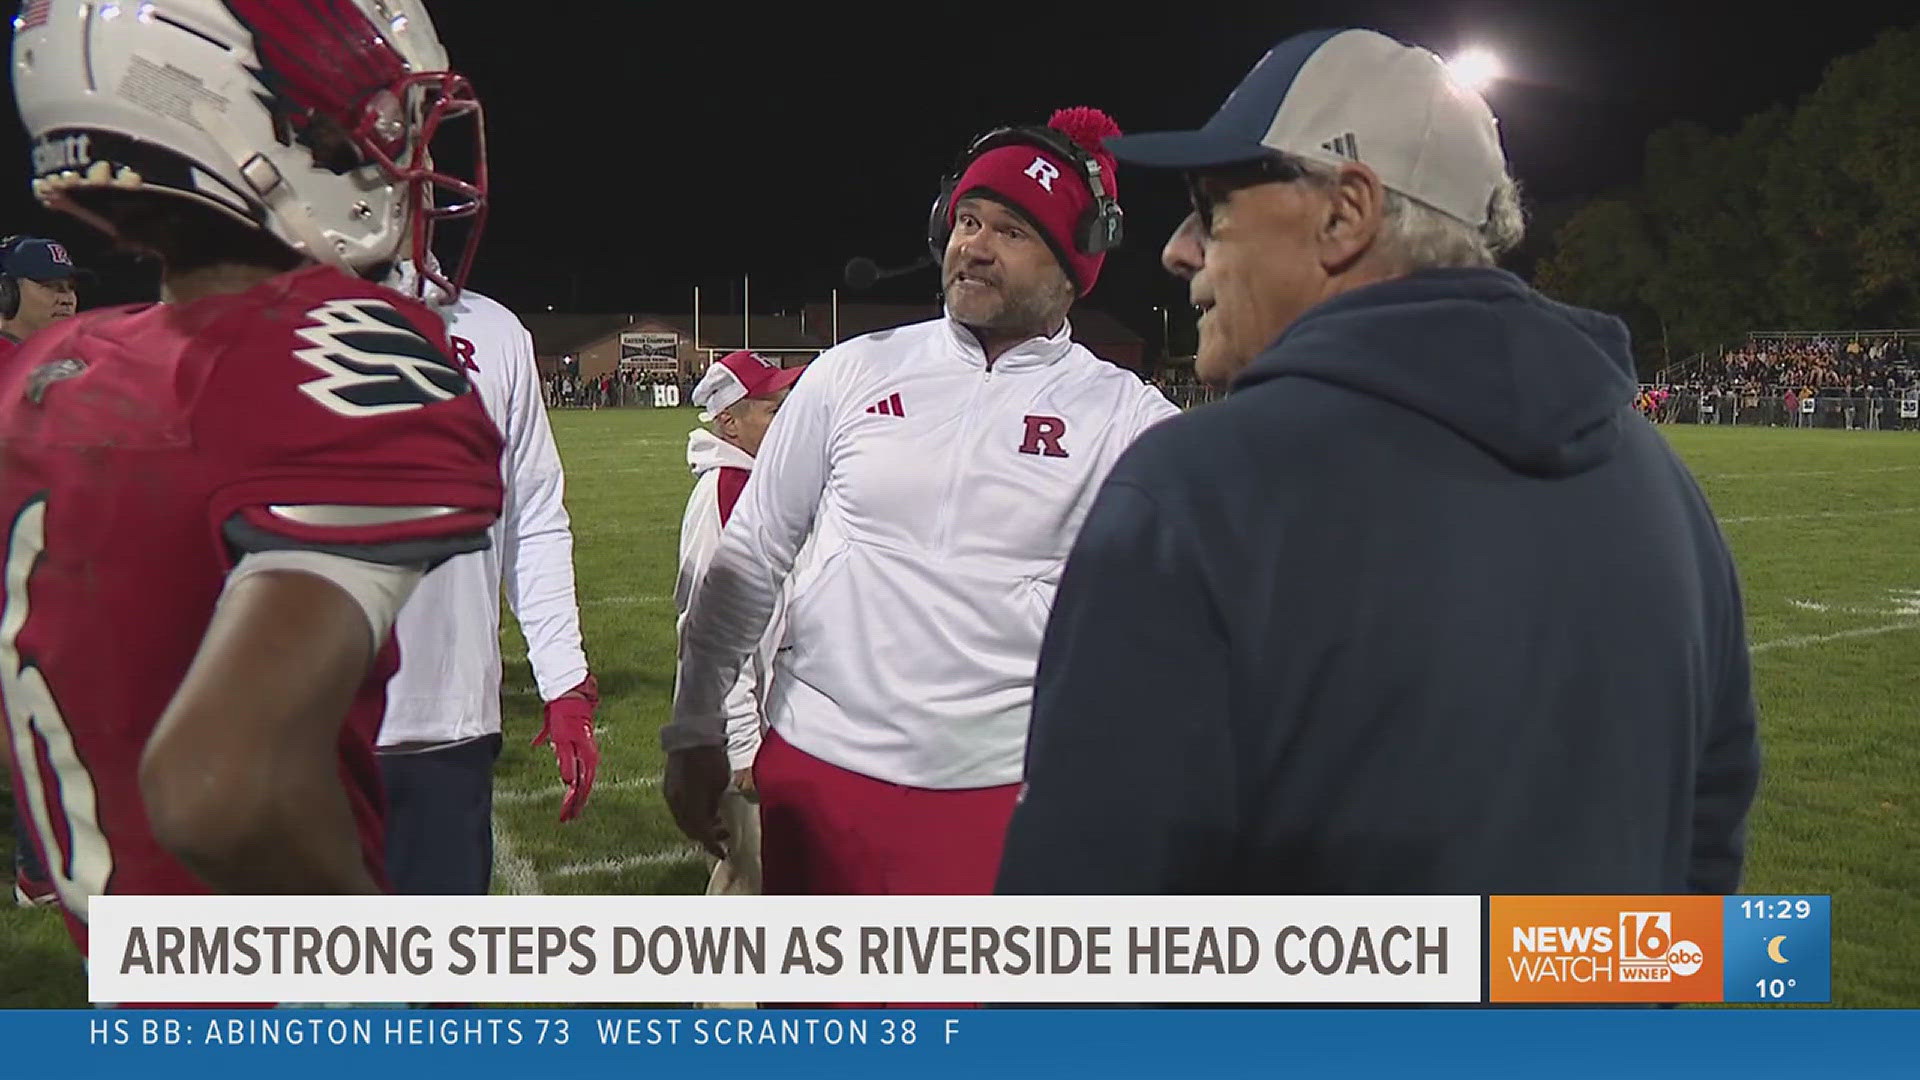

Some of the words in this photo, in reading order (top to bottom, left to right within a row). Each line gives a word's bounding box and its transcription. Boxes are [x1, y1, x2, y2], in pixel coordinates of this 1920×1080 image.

[33, 134, 92, 175] chutt
[1024, 156, 1060, 192] R
[450, 335, 481, 373] R
[1019, 415, 1069, 458] R
